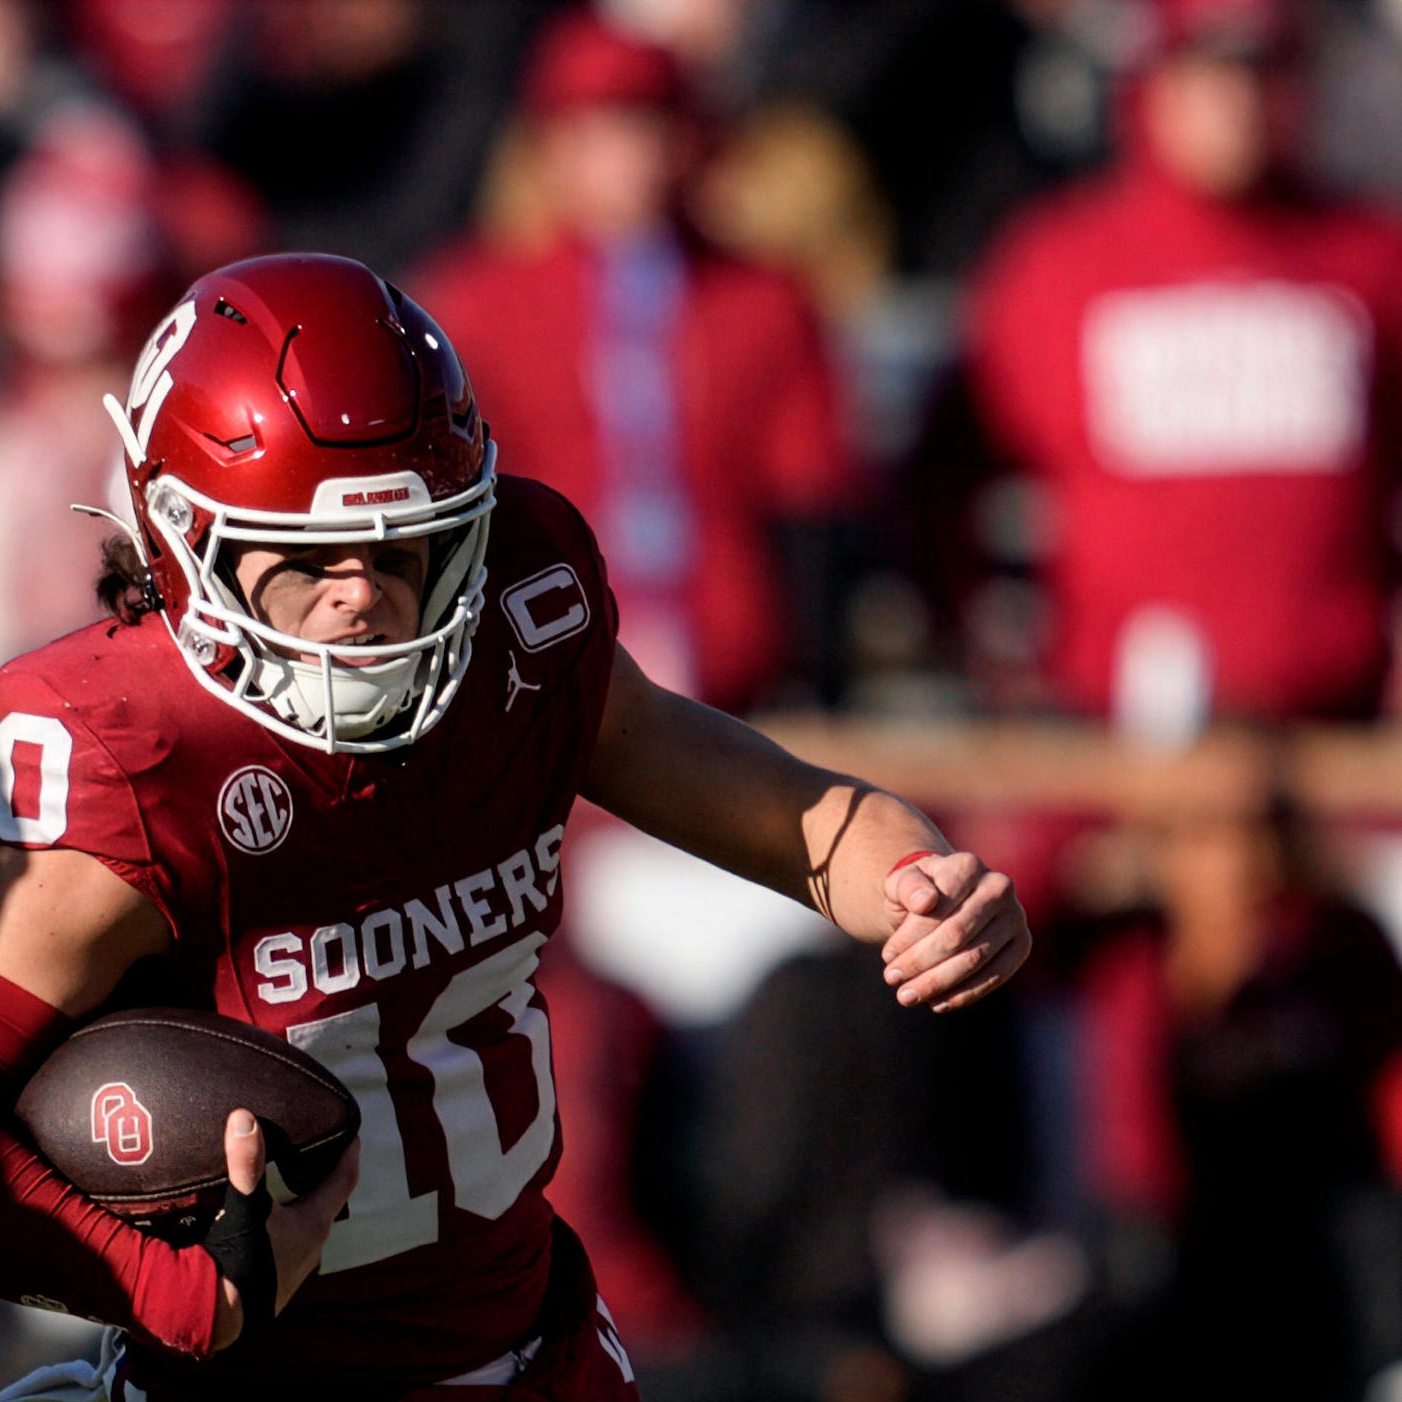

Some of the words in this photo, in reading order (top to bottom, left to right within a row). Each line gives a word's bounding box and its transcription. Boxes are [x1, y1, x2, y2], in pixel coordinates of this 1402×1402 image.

[506, 569, 585, 646] C
[224, 772, 288, 849] SEC
[253, 824, 565, 1006] SOONERS
[286, 930, 556, 1276] 10
